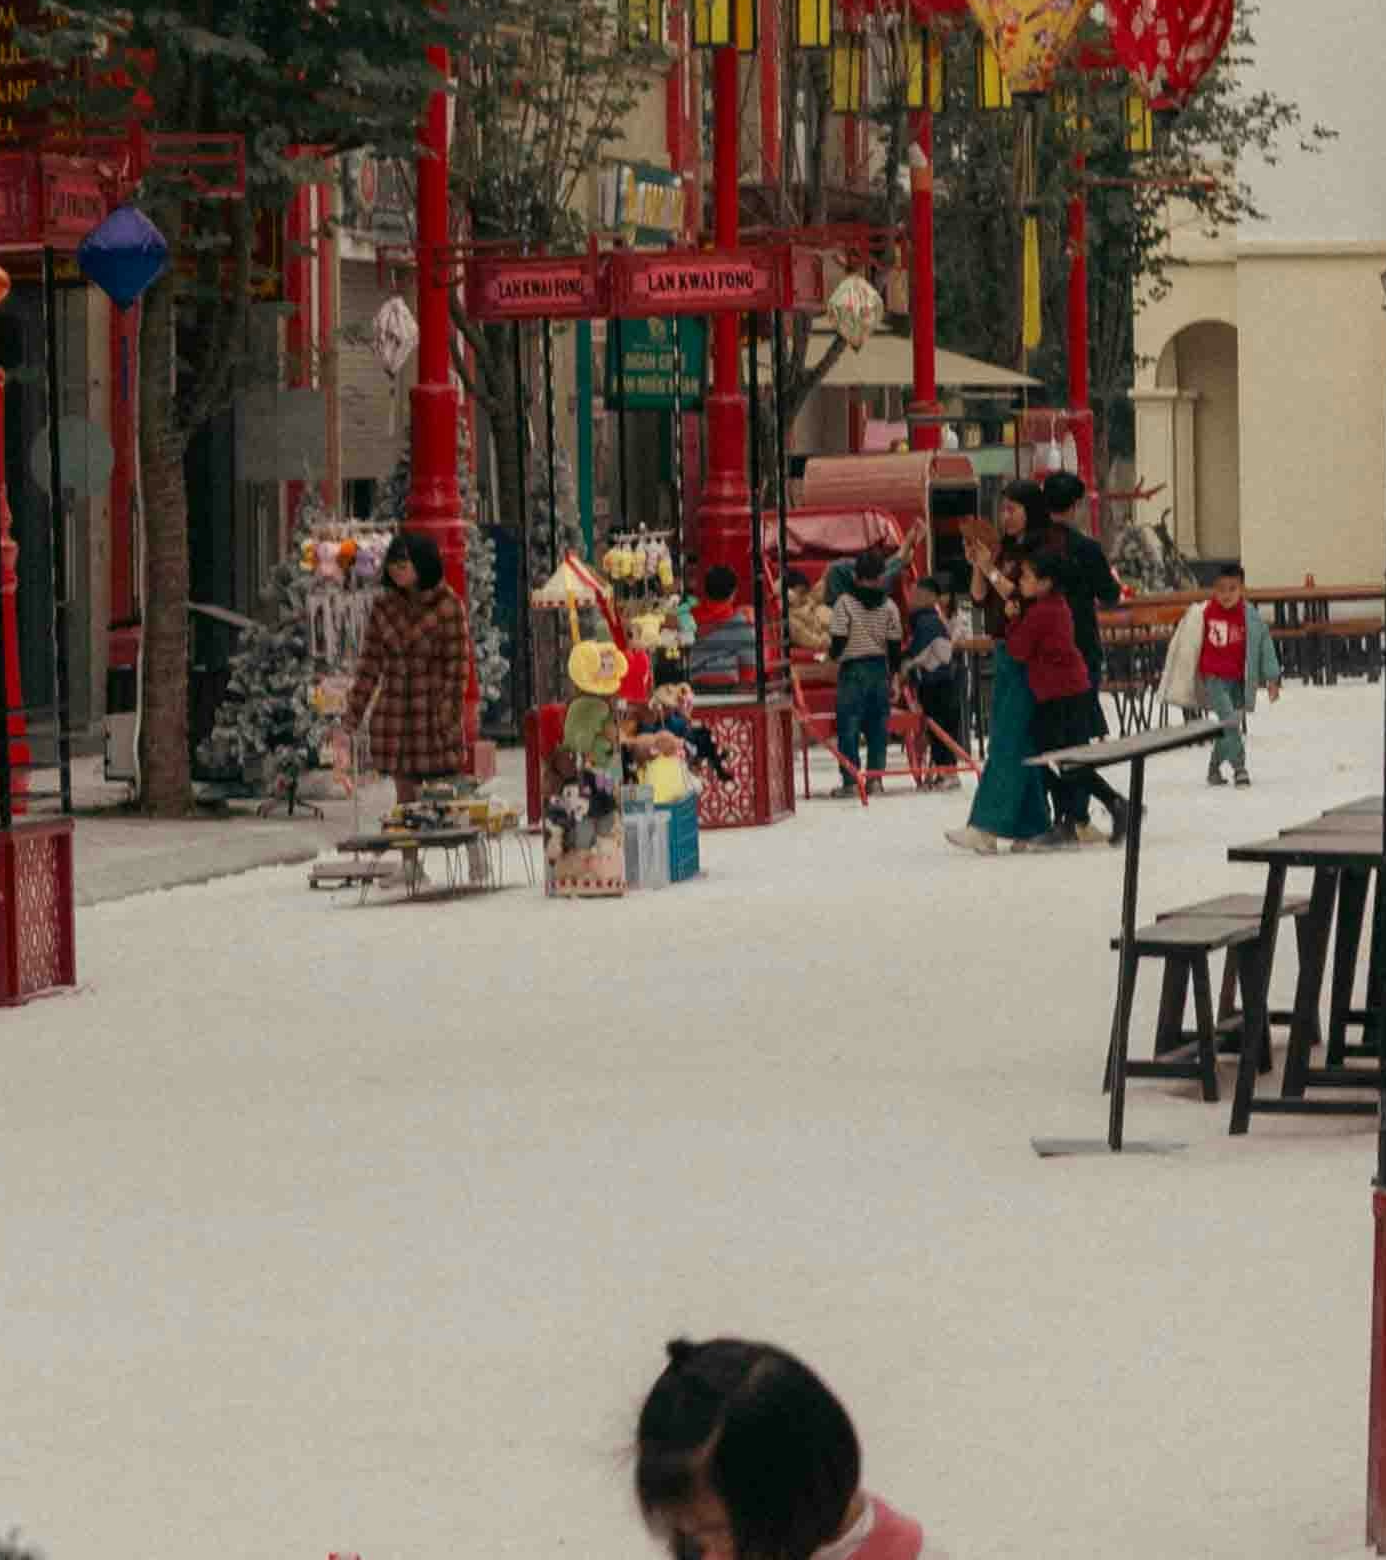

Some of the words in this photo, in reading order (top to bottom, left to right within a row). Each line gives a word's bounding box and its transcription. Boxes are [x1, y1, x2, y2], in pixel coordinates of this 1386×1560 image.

[647, 273, 673, 291] LAN
[677, 271, 716, 290] KWAI
[718, 271, 754, 289] FONG
